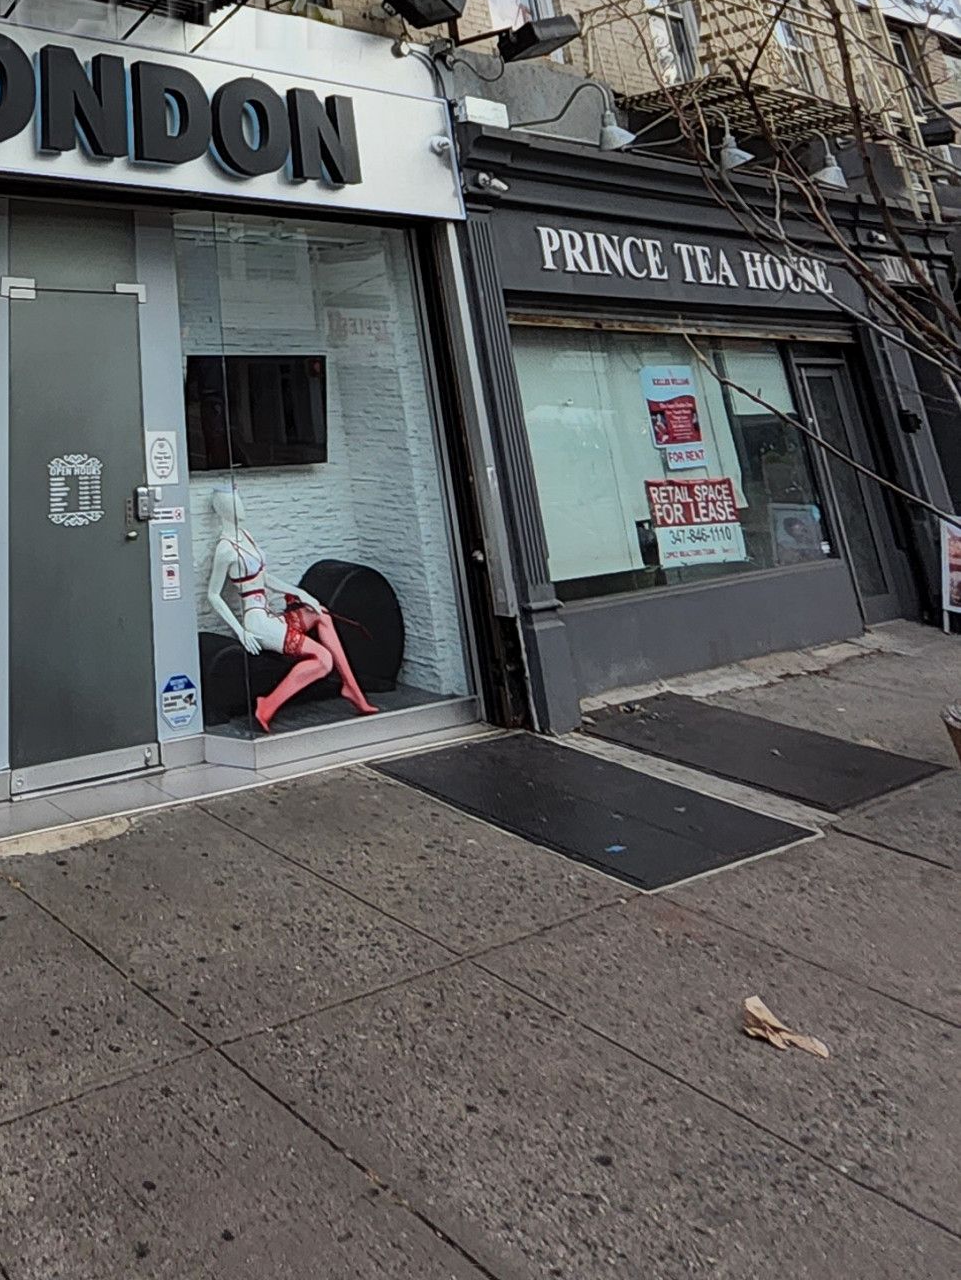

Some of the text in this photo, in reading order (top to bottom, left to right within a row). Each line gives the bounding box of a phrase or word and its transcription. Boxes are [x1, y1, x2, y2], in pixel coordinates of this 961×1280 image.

[536, 227, 669, 281] PRINCE
[673, 243, 739, 287] TEA
[741, 252, 834, 295] HOUSE
[668, 450, 705, 463] FOR RENT
[49, 464, 102, 476] OPEN HOURS
[649, 484, 731, 503] RETAIL SPACE
[654, 501, 736, 525] FOR LEASE
